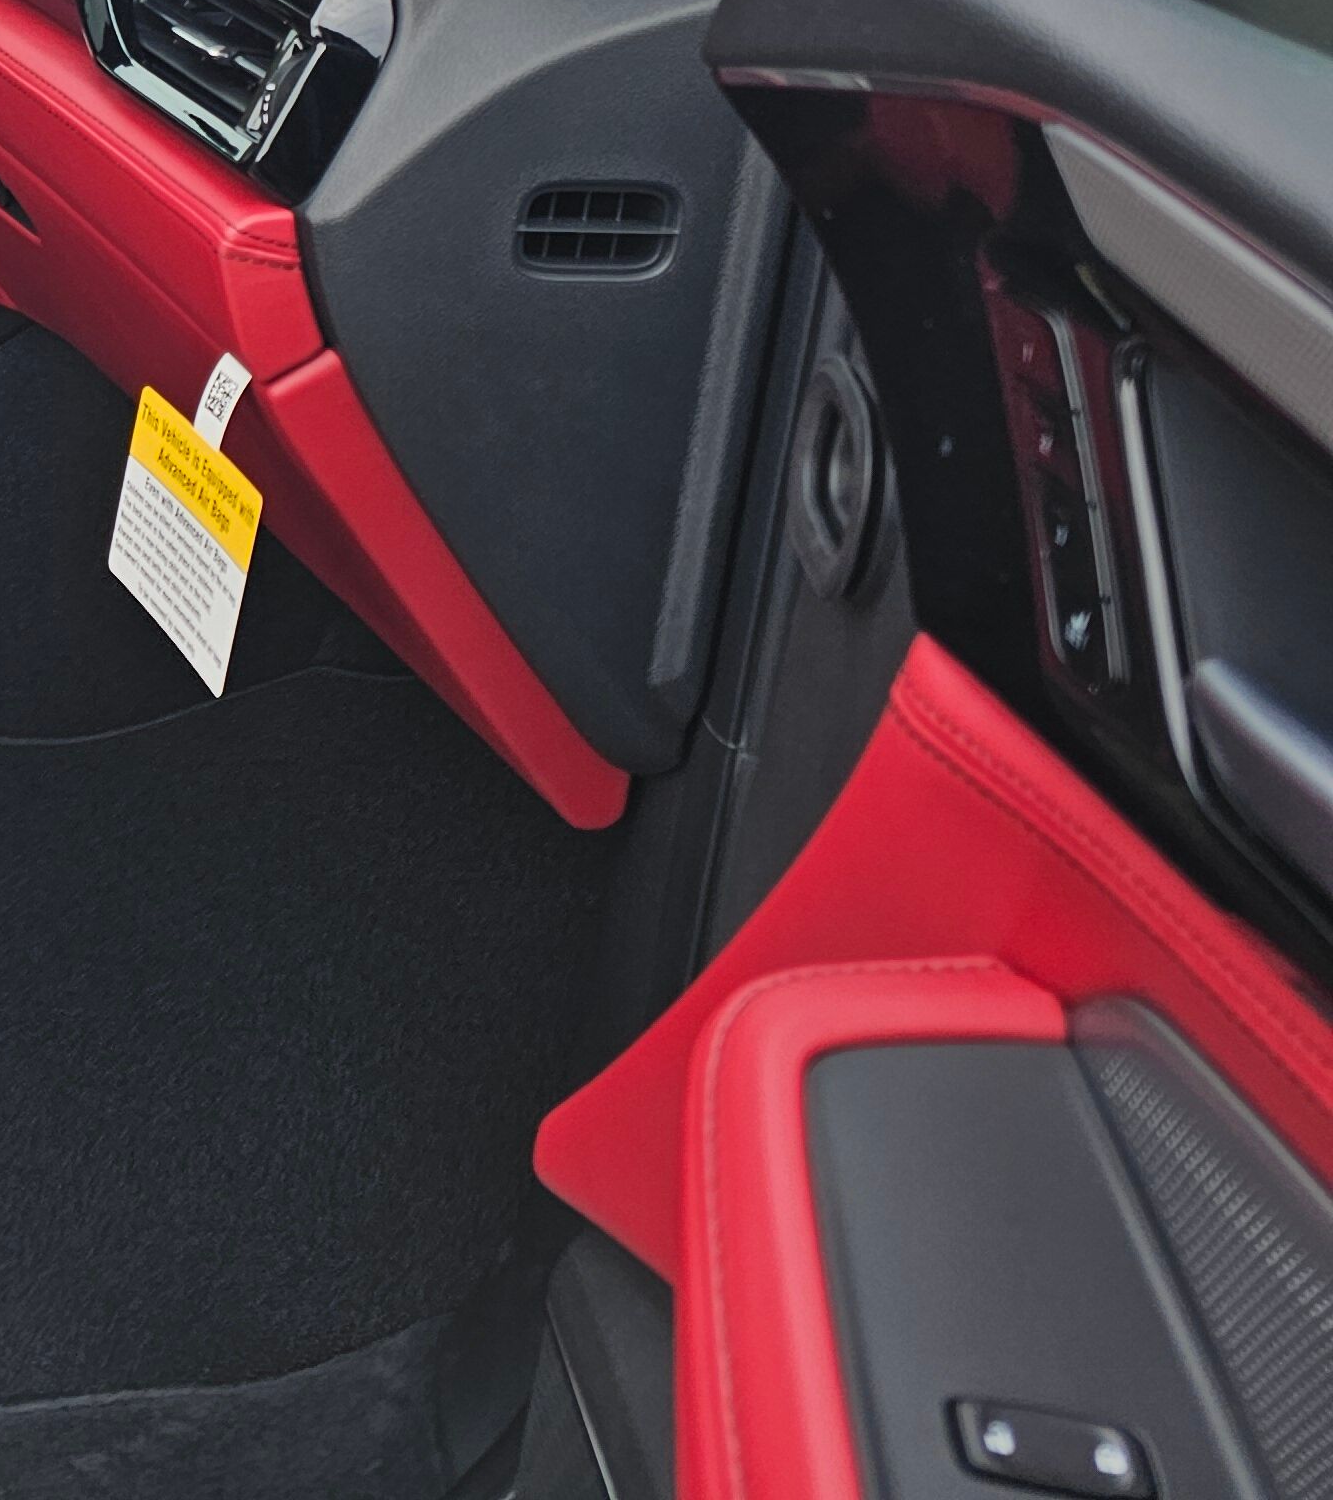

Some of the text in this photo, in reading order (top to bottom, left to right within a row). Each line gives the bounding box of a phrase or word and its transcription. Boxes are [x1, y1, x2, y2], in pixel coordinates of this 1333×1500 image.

[141, 402, 159, 432] This
[161, 419, 190, 461] Vehicle
[192, 448, 200, 470] is
[201, 458, 239, 509] Equipped
[157, 447, 230, 534] Advanced Air Bags
